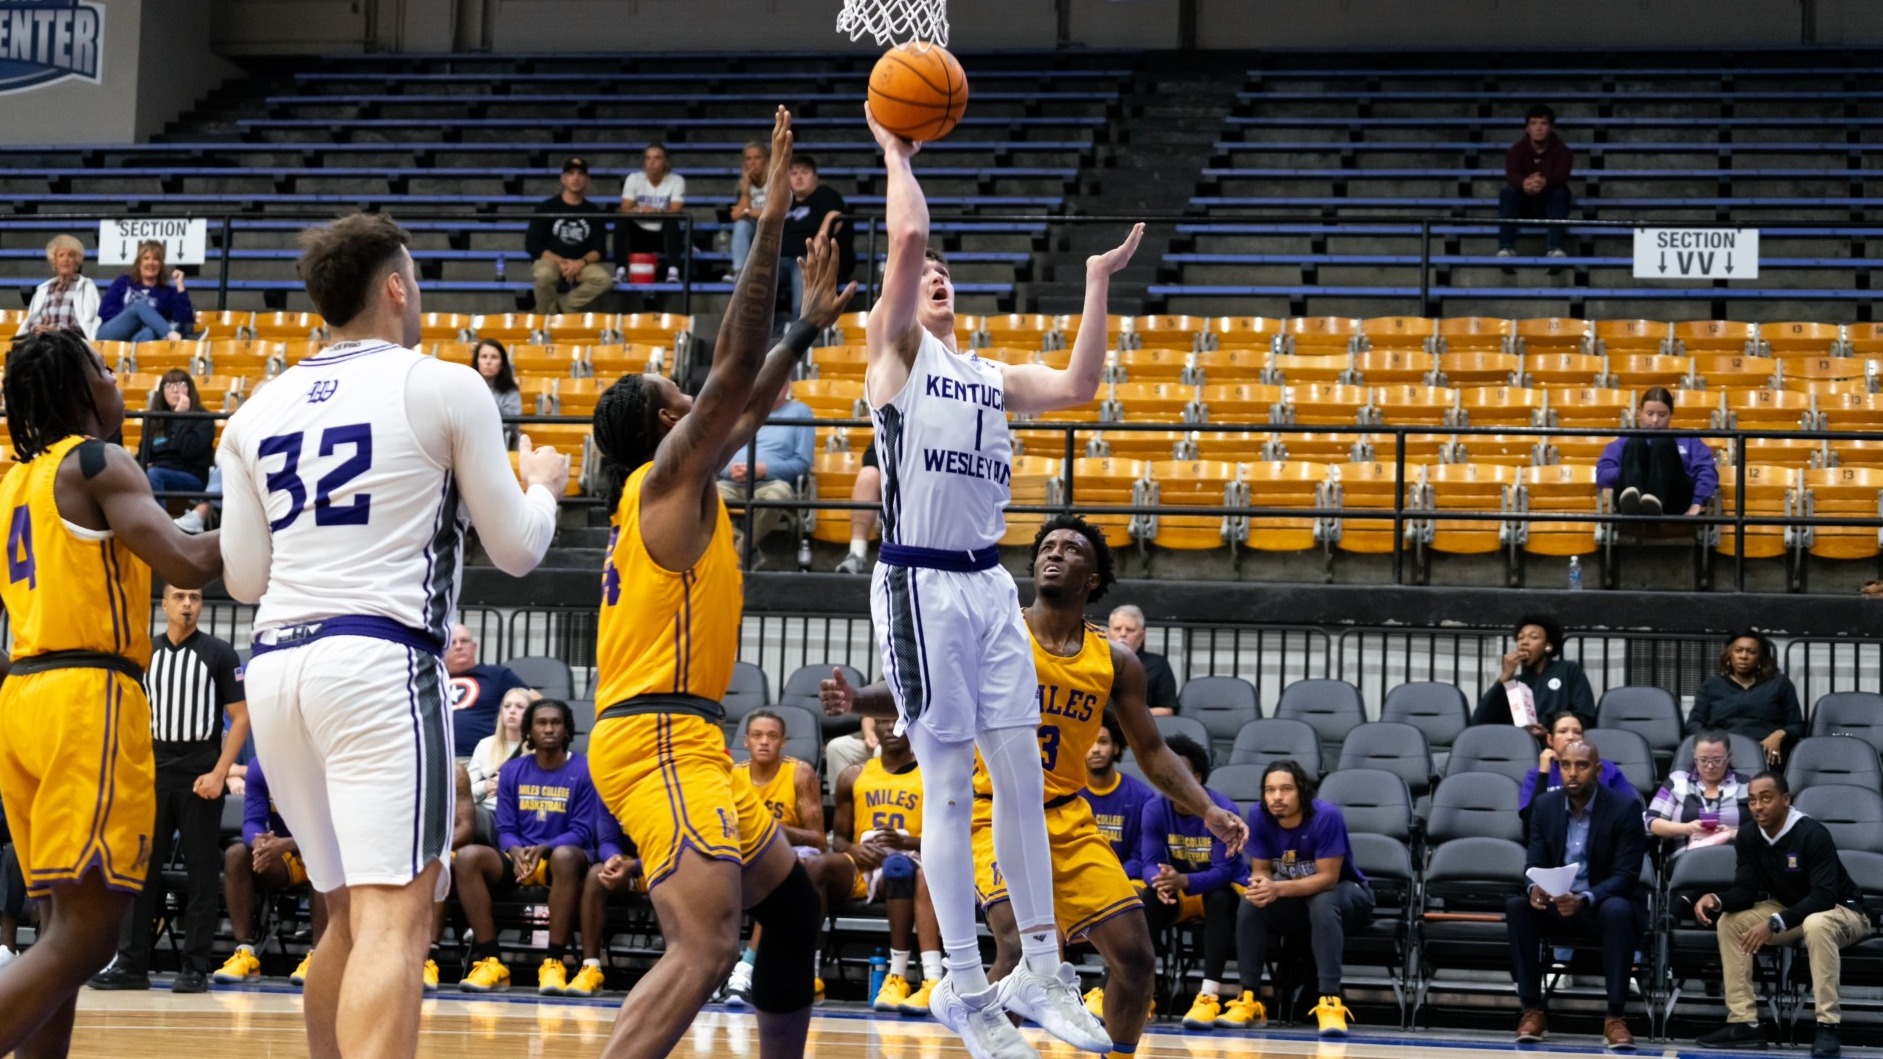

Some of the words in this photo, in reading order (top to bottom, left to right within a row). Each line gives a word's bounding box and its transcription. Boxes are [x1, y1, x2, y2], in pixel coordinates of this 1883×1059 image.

[119, 221, 187, 237] SECTION
[1657, 231, 1735, 249] SECTION
[1677, 251, 1715, 275] VV
[1708, 324, 1719, 332] 12
[1792, 324, 1802, 333] 13
[1732, 359, 1742, 368] 12
[1819, 360, 1830, 369] 13
[926, 374, 1004, 412] KENTUC
[1759, 392, 1770, 401] 12
[974, 408, 983, 452] 1
[923, 448, 1011, 487] WESLEYAN
[1102, 461, 1109, 470] 5
[1192, 464, 1200, 473] 6
[1375, 464, 1382, 474] 8
[258, 422, 373, 535] 32
[1749, 468, 1760, 478] 12
[1843, 470, 1855, 480] 13
[7, 503, 36, 591] 4
[1037, 725, 1060, 772] 3
[865, 788, 918, 811] MILES
